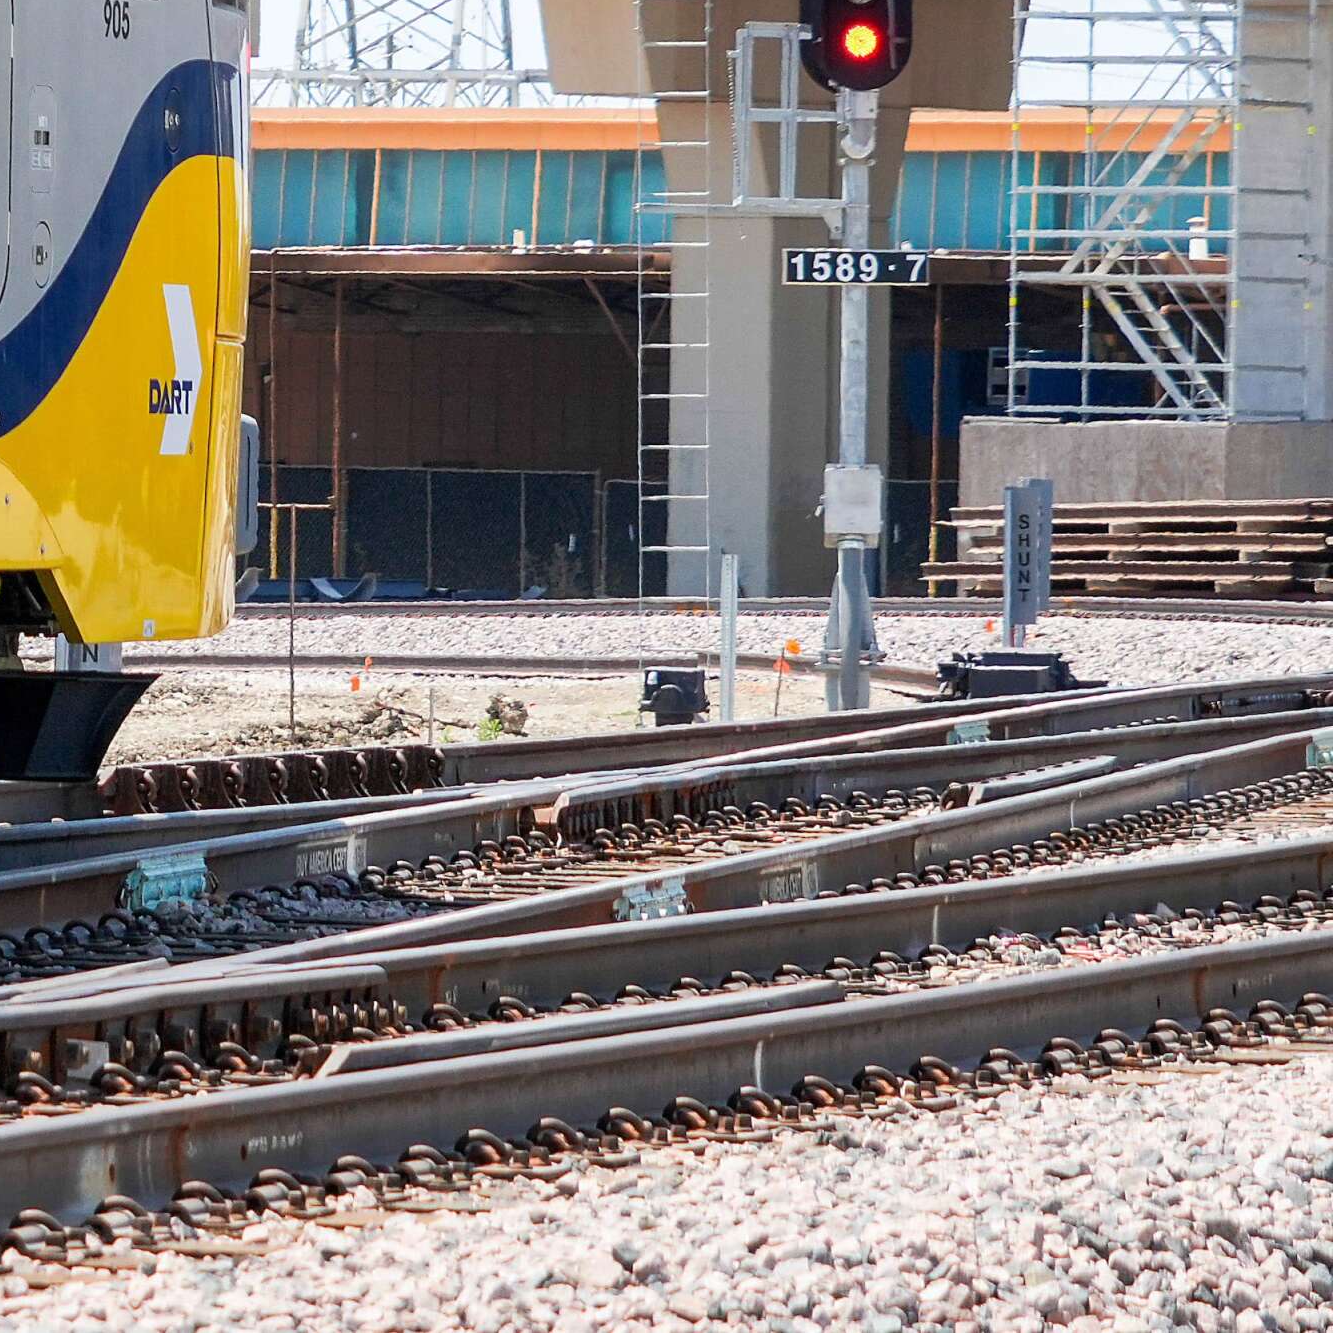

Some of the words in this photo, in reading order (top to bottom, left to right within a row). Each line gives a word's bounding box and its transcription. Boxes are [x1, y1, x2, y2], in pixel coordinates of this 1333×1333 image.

[104, 0, 130, 39] 905
[148, 378, 193, 415] DART
[1017, 515, 1031, 603] SHUNT
